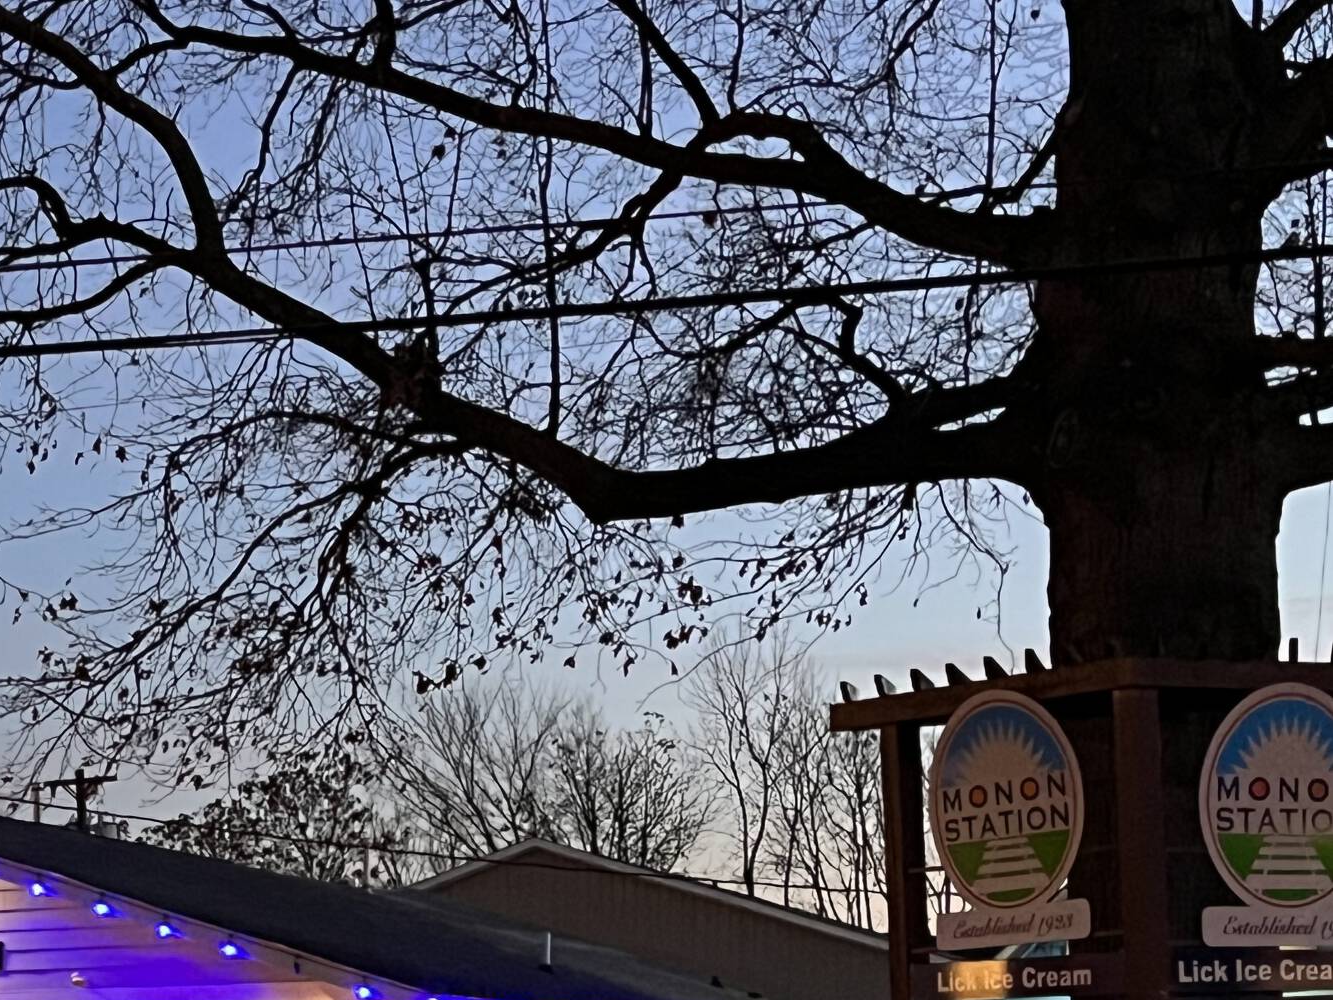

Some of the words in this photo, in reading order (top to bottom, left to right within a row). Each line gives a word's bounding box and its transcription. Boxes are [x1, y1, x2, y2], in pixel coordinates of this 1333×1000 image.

[943, 772, 1066, 814] MONON
[1217, 776, 1330, 802] MONO
[945, 802, 1070, 842] STATION
[1217, 807, 1333, 833] STATIO
[953, 914, 1036, 939] Established
[1223, 916, 1318, 936] Established
[937, 970, 977, 992] Lick
[984, 969, 1014, 991] Ice
[1022, 967, 1092, 988] Cream
[1178, 960, 1228, 983] Lick
[1236, 959, 1272, 982] Ice
[1279, 959, 1333, 980] Crea
